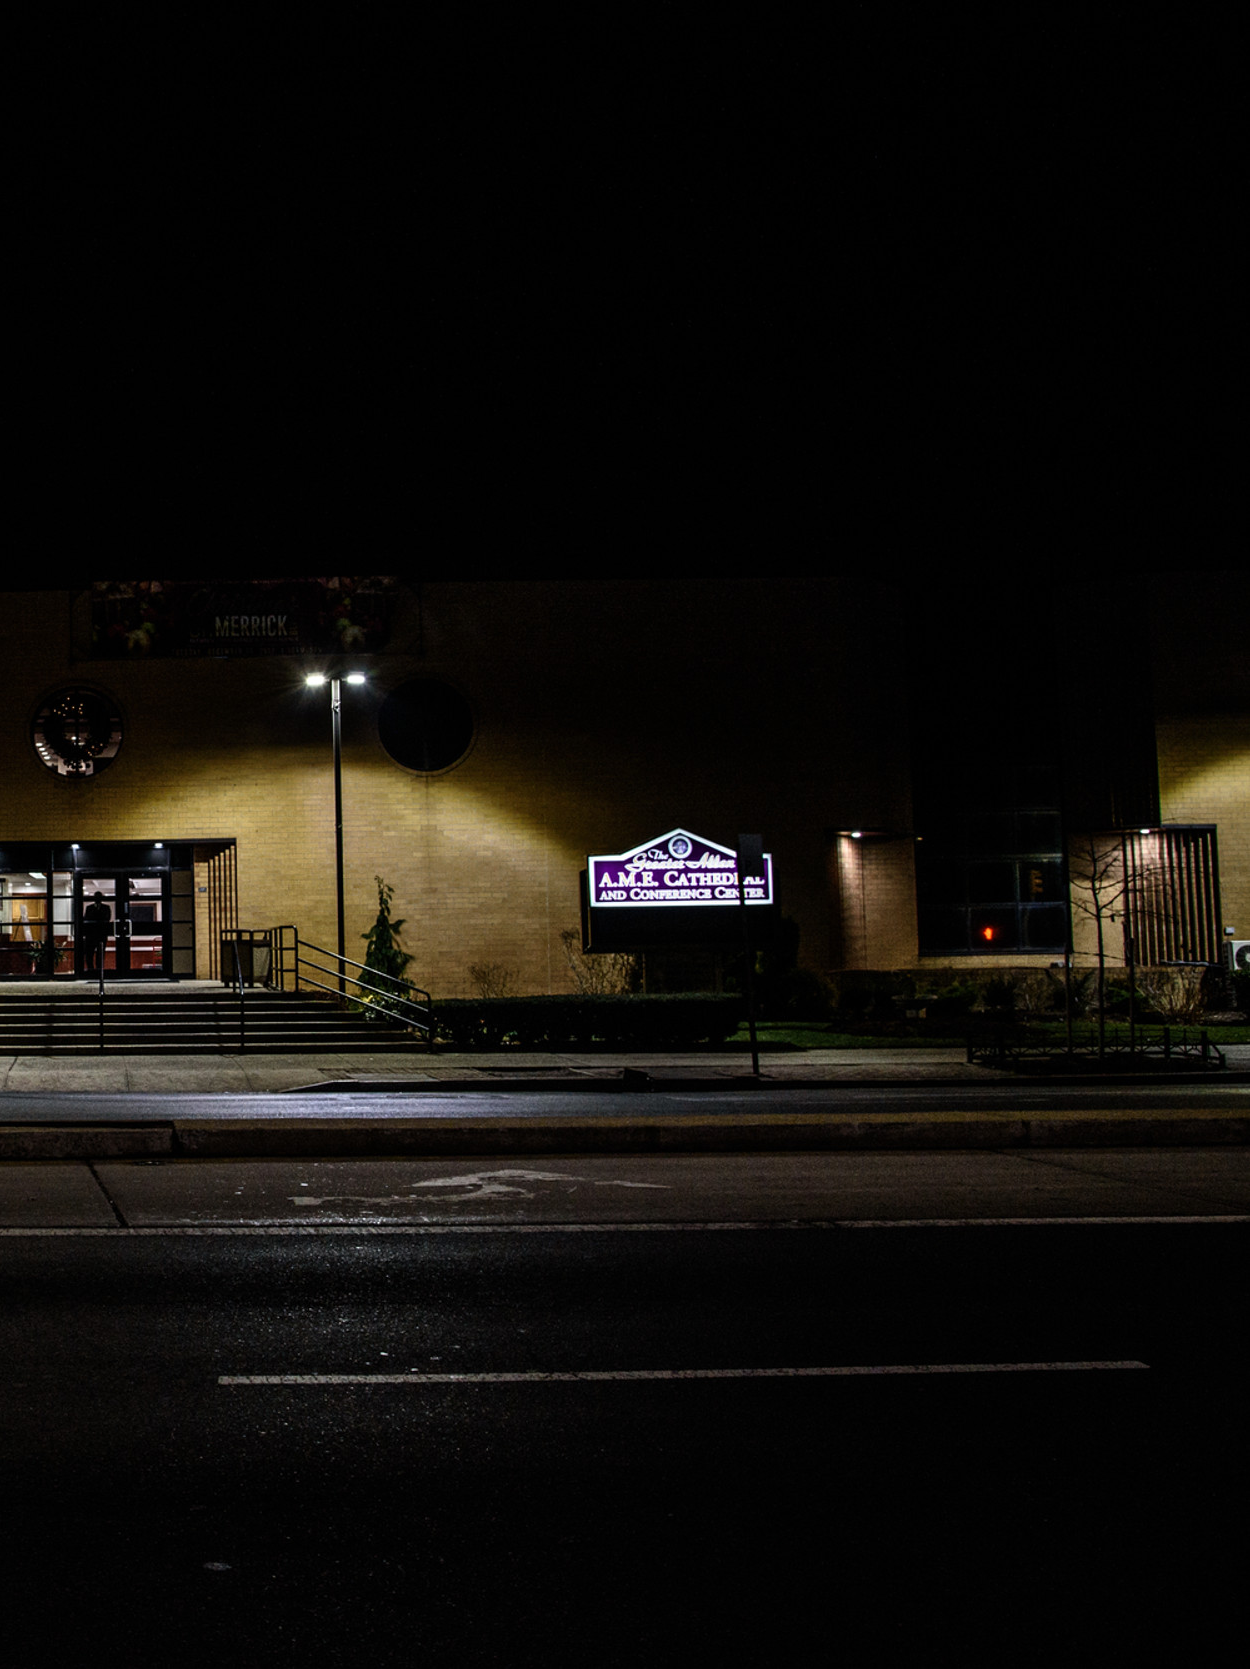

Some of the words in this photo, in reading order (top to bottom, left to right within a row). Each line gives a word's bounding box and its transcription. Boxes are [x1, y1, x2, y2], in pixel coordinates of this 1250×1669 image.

[215, 614, 288, 637] MERRICK
[624, 852, 686, 872] Greater
[685, 851, 736, 869] Allen
[647, 849, 669, 860] The
[599, 872, 659, 887] A.M.E.
[599, 890, 627, 901] AND
[630, 888, 712, 900] CONFERENCE
